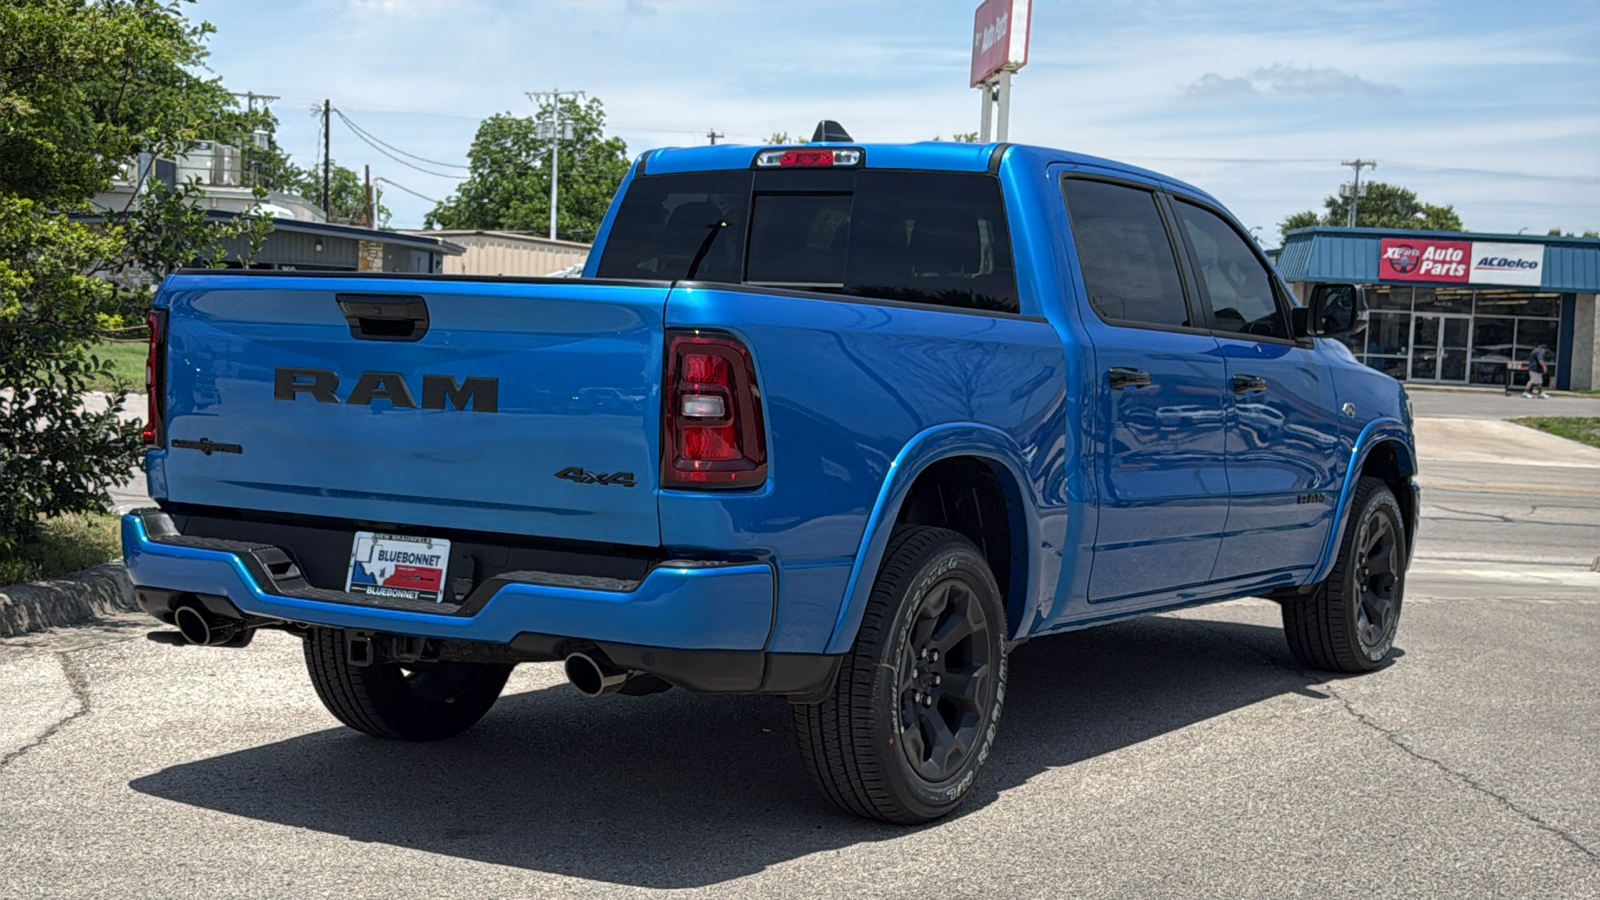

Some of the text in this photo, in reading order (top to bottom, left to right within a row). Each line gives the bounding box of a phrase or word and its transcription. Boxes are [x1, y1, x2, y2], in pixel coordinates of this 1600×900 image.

[1421, 245, 1463, 262] Auto
[1419, 260, 1467, 277] Parts
[1477, 256, 1539, 270] ACDelco
[273, 366, 499, 413] RAM
[391, 535, 432, 544] BRAUNFELS
[377, 549, 442, 567] BLUEBONNET
[366, 586, 420, 600] BLUEBONNET
